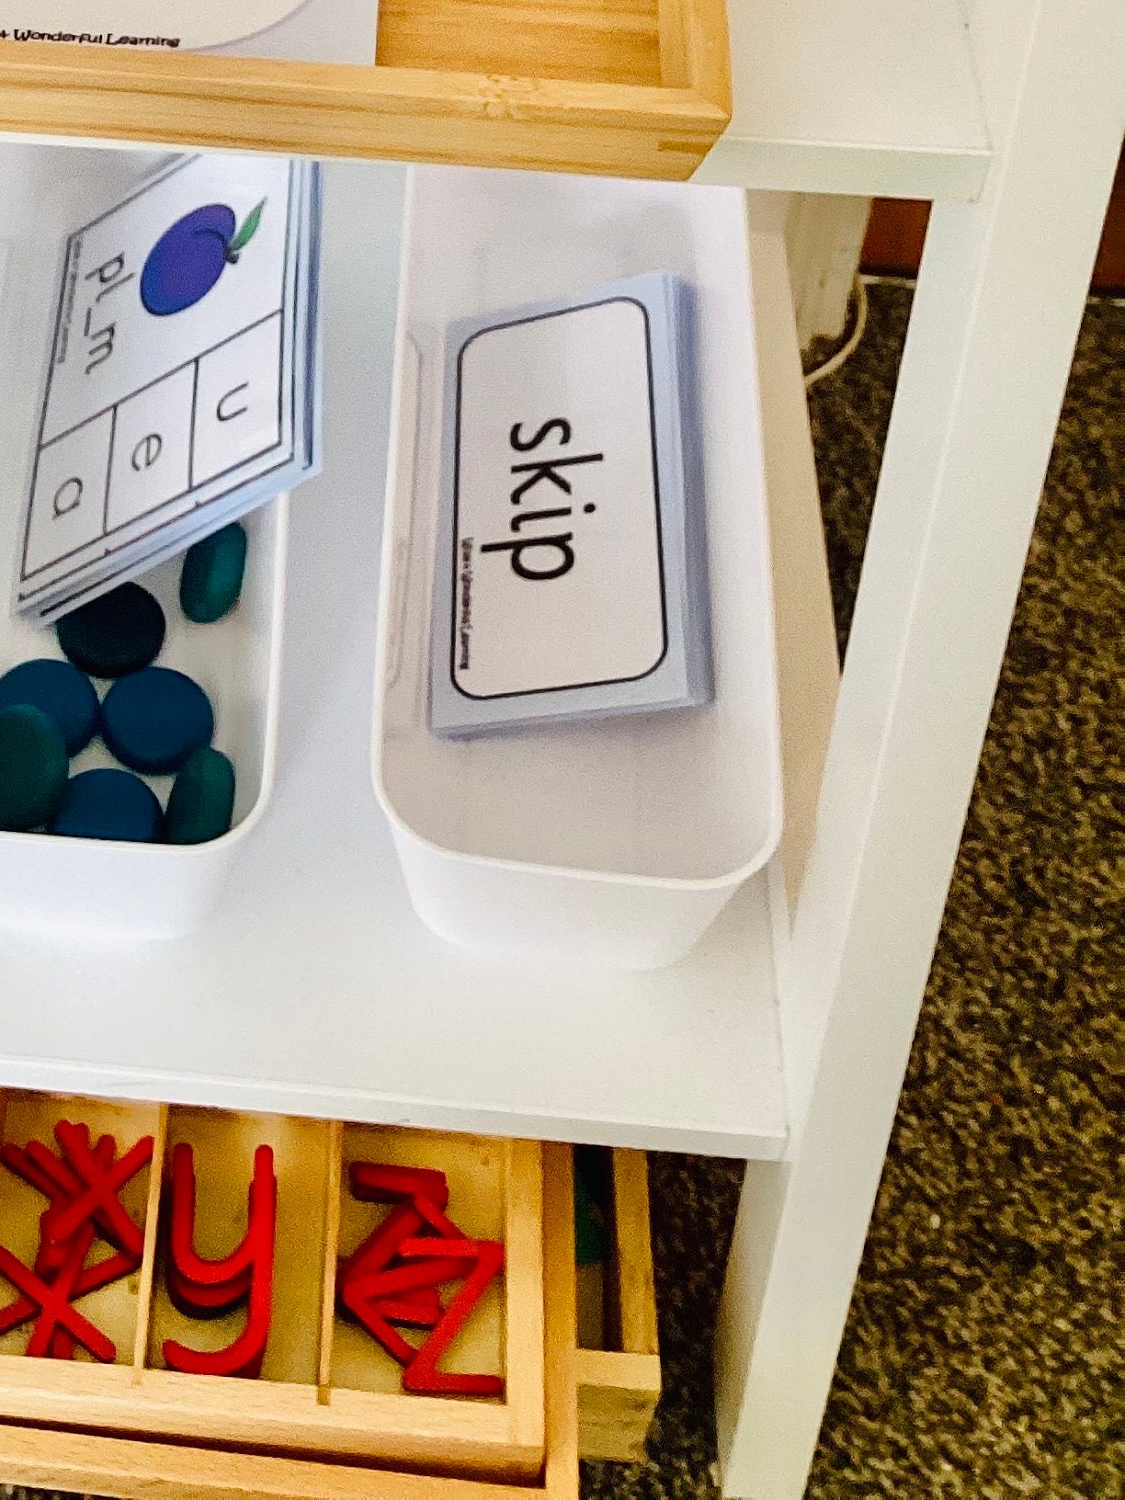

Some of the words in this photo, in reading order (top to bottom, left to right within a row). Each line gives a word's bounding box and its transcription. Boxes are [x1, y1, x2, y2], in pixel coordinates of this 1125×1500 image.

[12, 29, 103, 45] Wonderful
[105, 33, 180, 48] Learning
[131, 433, 163, 472] e
[52, 476, 84, 520] a
[480, 416, 604, 581] skip
